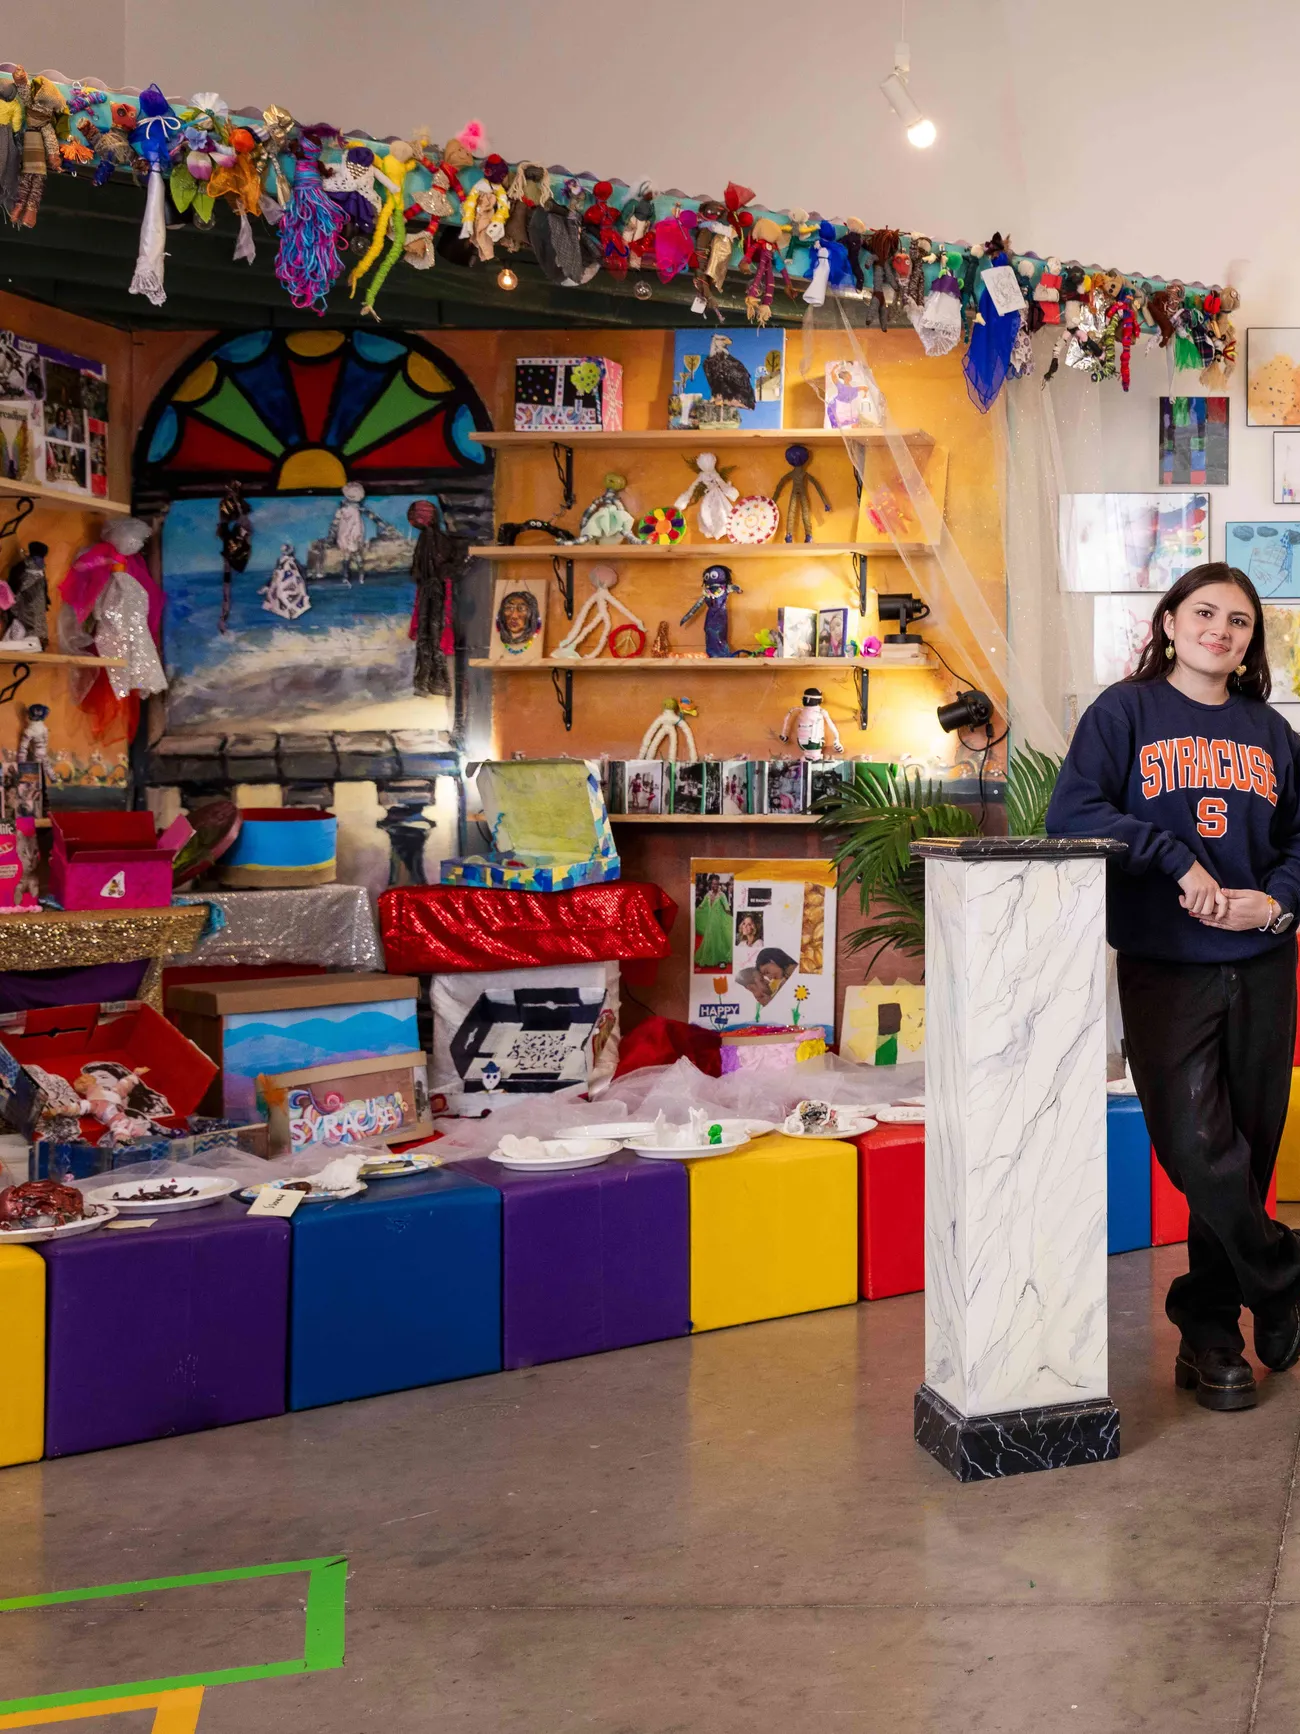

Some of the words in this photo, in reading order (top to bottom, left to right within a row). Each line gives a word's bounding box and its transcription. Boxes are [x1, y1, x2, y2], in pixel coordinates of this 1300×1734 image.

[1139, 735, 1278, 807] SYRACUSE
[1196, 796, 1228, 838] S
[700, 1005, 739, 1017] HAPPY
[290, 1098, 396, 1146] SYRACUSE
